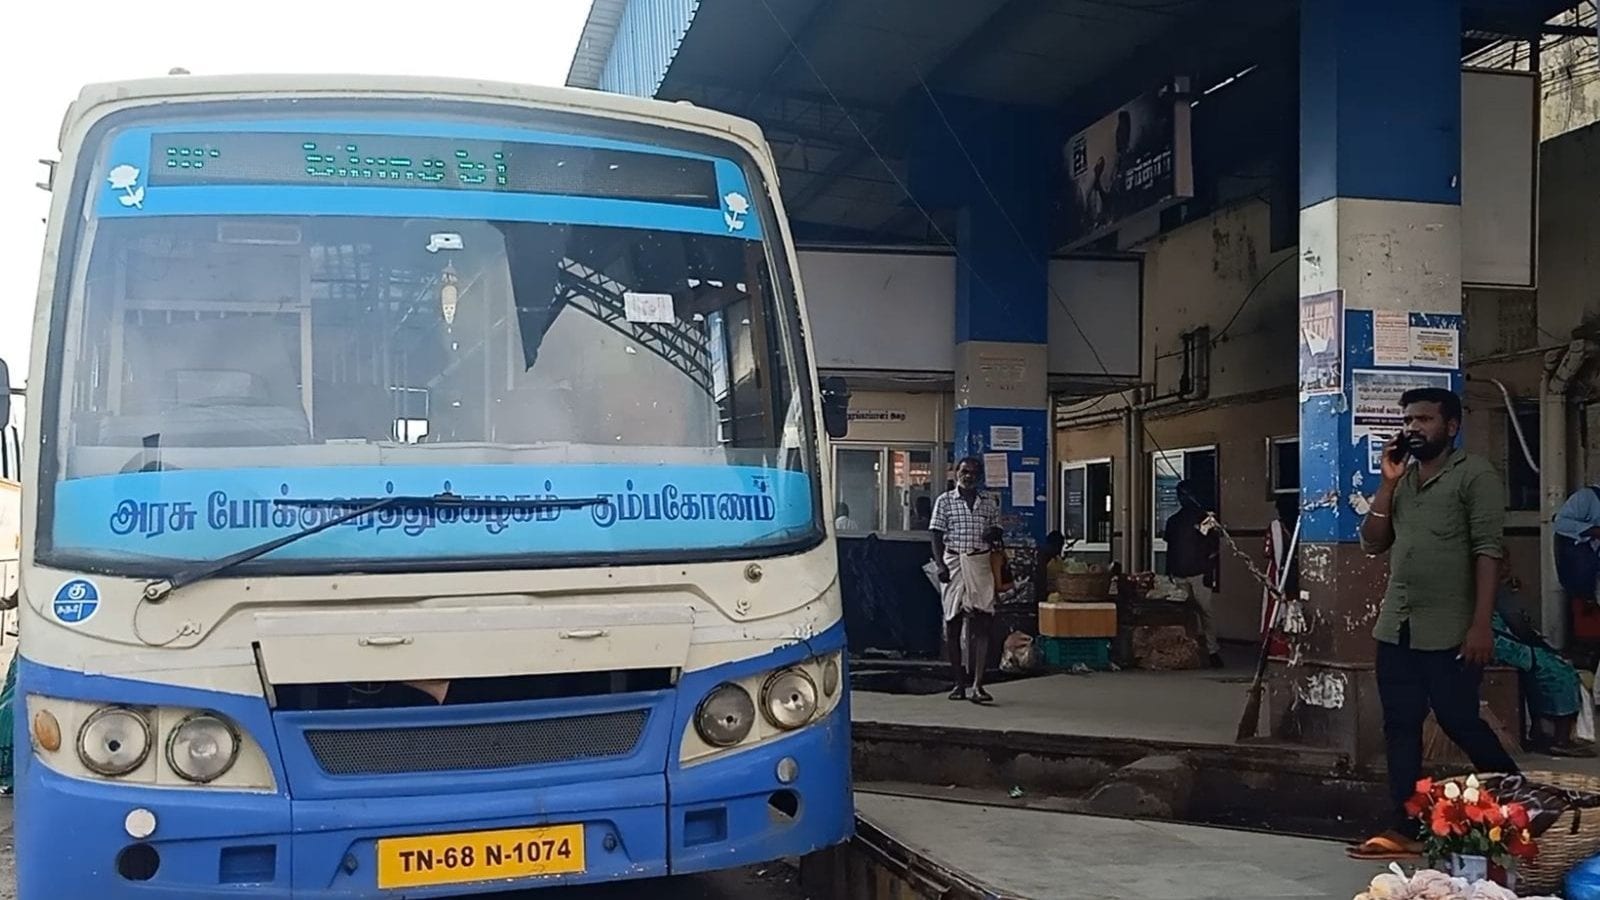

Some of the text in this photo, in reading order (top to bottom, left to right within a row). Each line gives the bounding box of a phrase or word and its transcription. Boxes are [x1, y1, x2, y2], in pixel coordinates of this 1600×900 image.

[110, 499, 198, 539] அரசு
[591, 477, 776, 528] கும்பகோணம்
[399, 838, 572, 872] TN-68 N-1074
